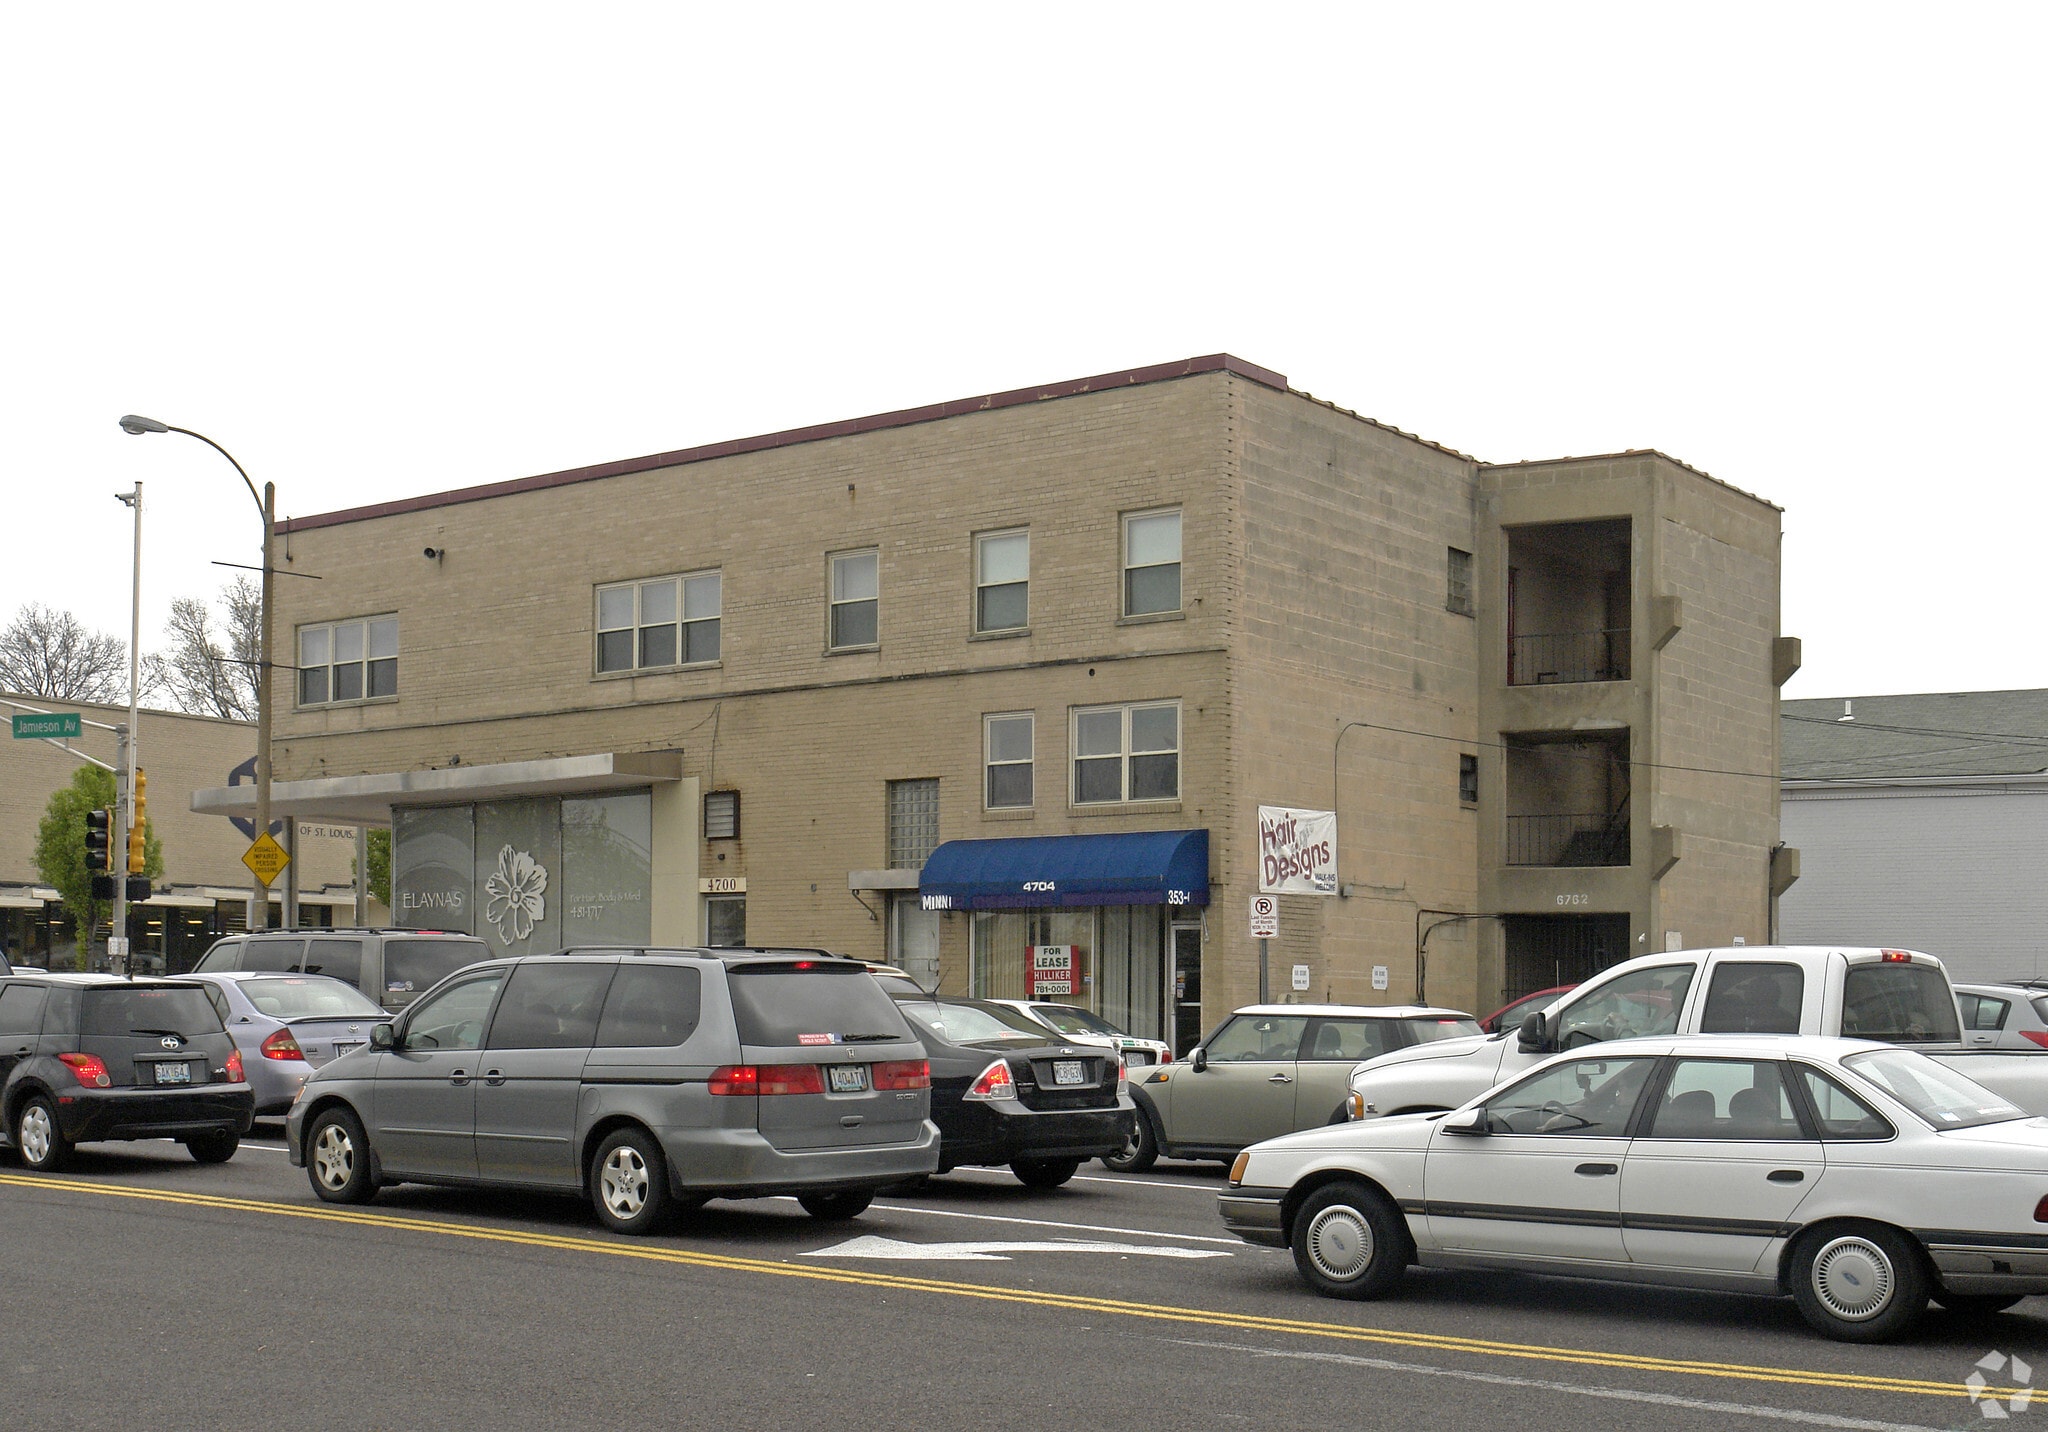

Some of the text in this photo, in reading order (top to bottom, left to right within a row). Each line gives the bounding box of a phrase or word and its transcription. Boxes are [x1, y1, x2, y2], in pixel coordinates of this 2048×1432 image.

[17, 719, 76, 734] Jamieson Av
[300, 826, 312, 836] OF
[315, 827, 326, 837] ST.
[1260, 812, 1297, 852] Hair
[1263, 840, 1330, 887] Designs
[707, 878, 737, 891] 4700
[1022, 881, 1056, 892] 4704
[403, 891, 462, 909] ELAYNAS
[1556, 893, 1588, 905] 6762
[1036, 957, 1069, 968] LEASE
[1034, 970, 1071, 980] HILLIKER
[1035, 985, 1070, 993] 781-0001
